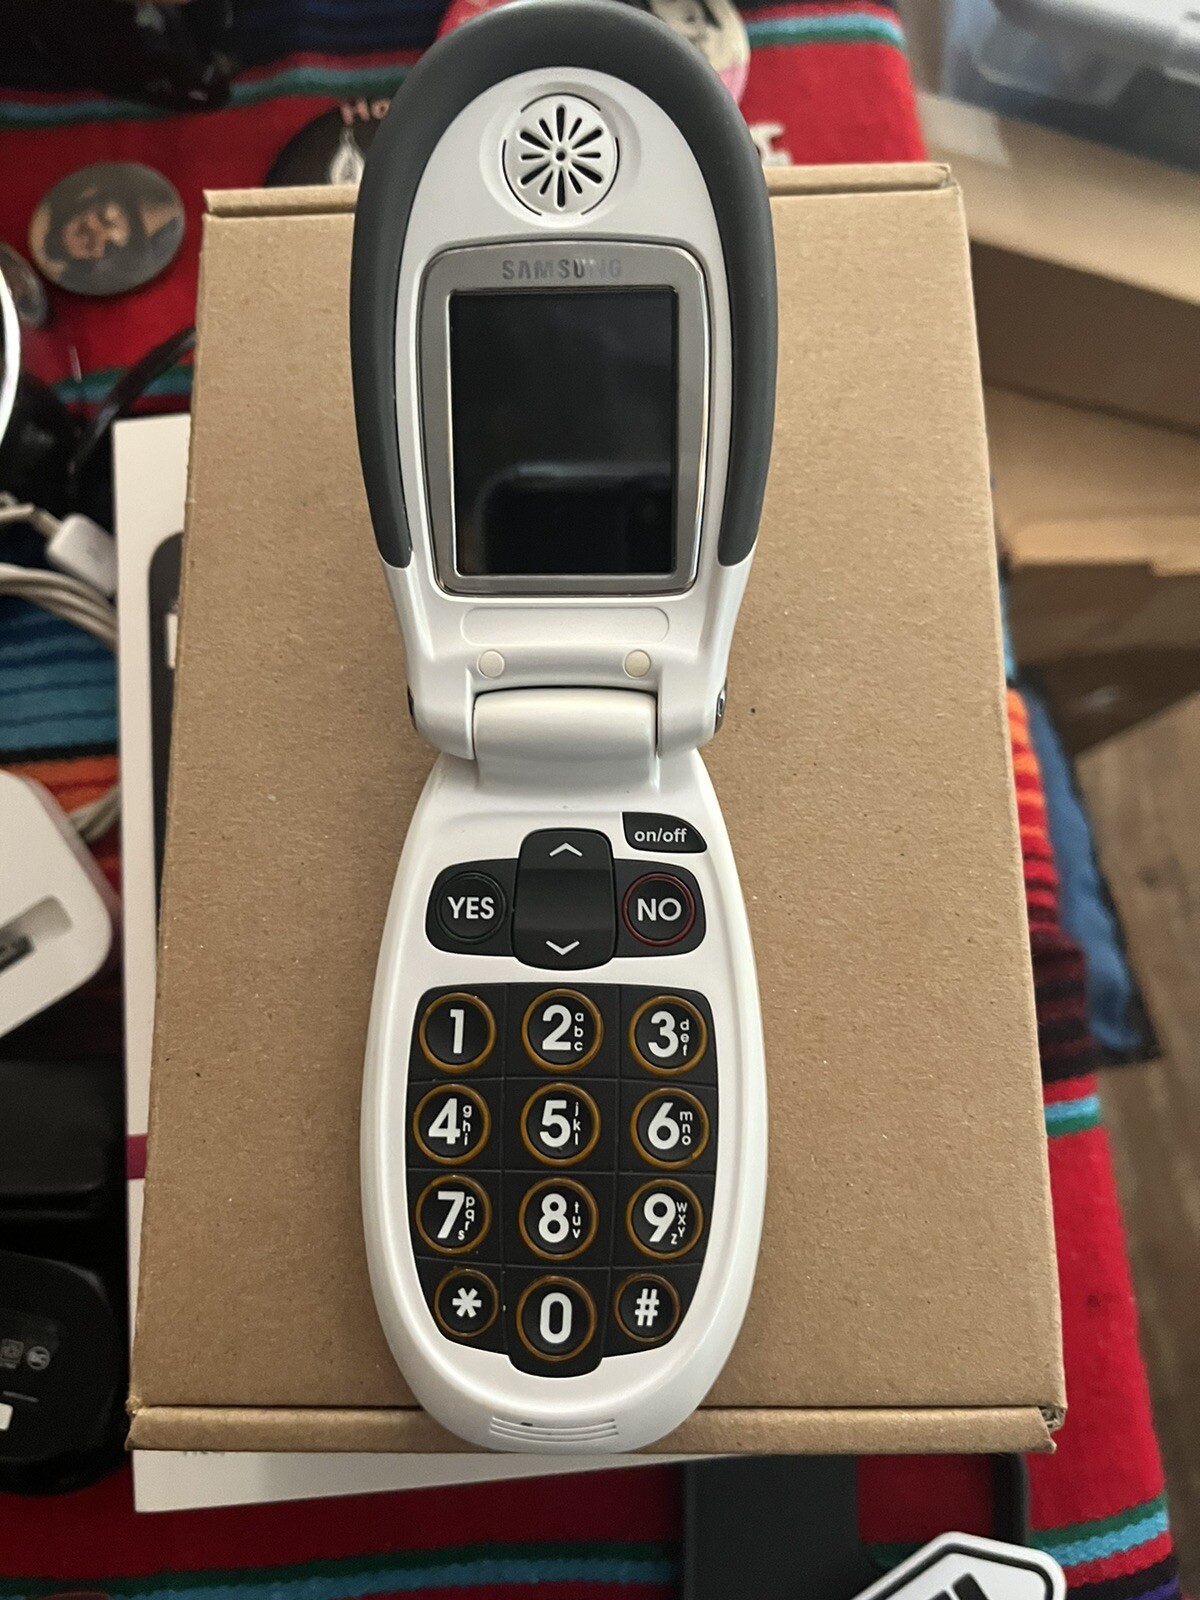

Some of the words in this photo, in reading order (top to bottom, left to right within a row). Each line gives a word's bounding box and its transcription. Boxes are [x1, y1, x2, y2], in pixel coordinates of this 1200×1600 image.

[634, 826, 688, 845] on/off
[447, 896, 495, 920] YES
[637, 897, 682, 922] NO
[449, 1008, 465, 1054] 1
[542, 1004, 572, 1051] 2
[648, 1010, 679, 1058] 3
[428, 1098, 460, 1145] 4
[539, 1099, 571, 1148] 5
[647, 1102, 680, 1150] 6
[437, 1190, 465, 1239] 7
[538, 1193, 570, 1244] 8
[643, 1193, 676, 1243] 9
[539, 1292, 573, 1344] 0
[634, 1288, 660, 1327] #
